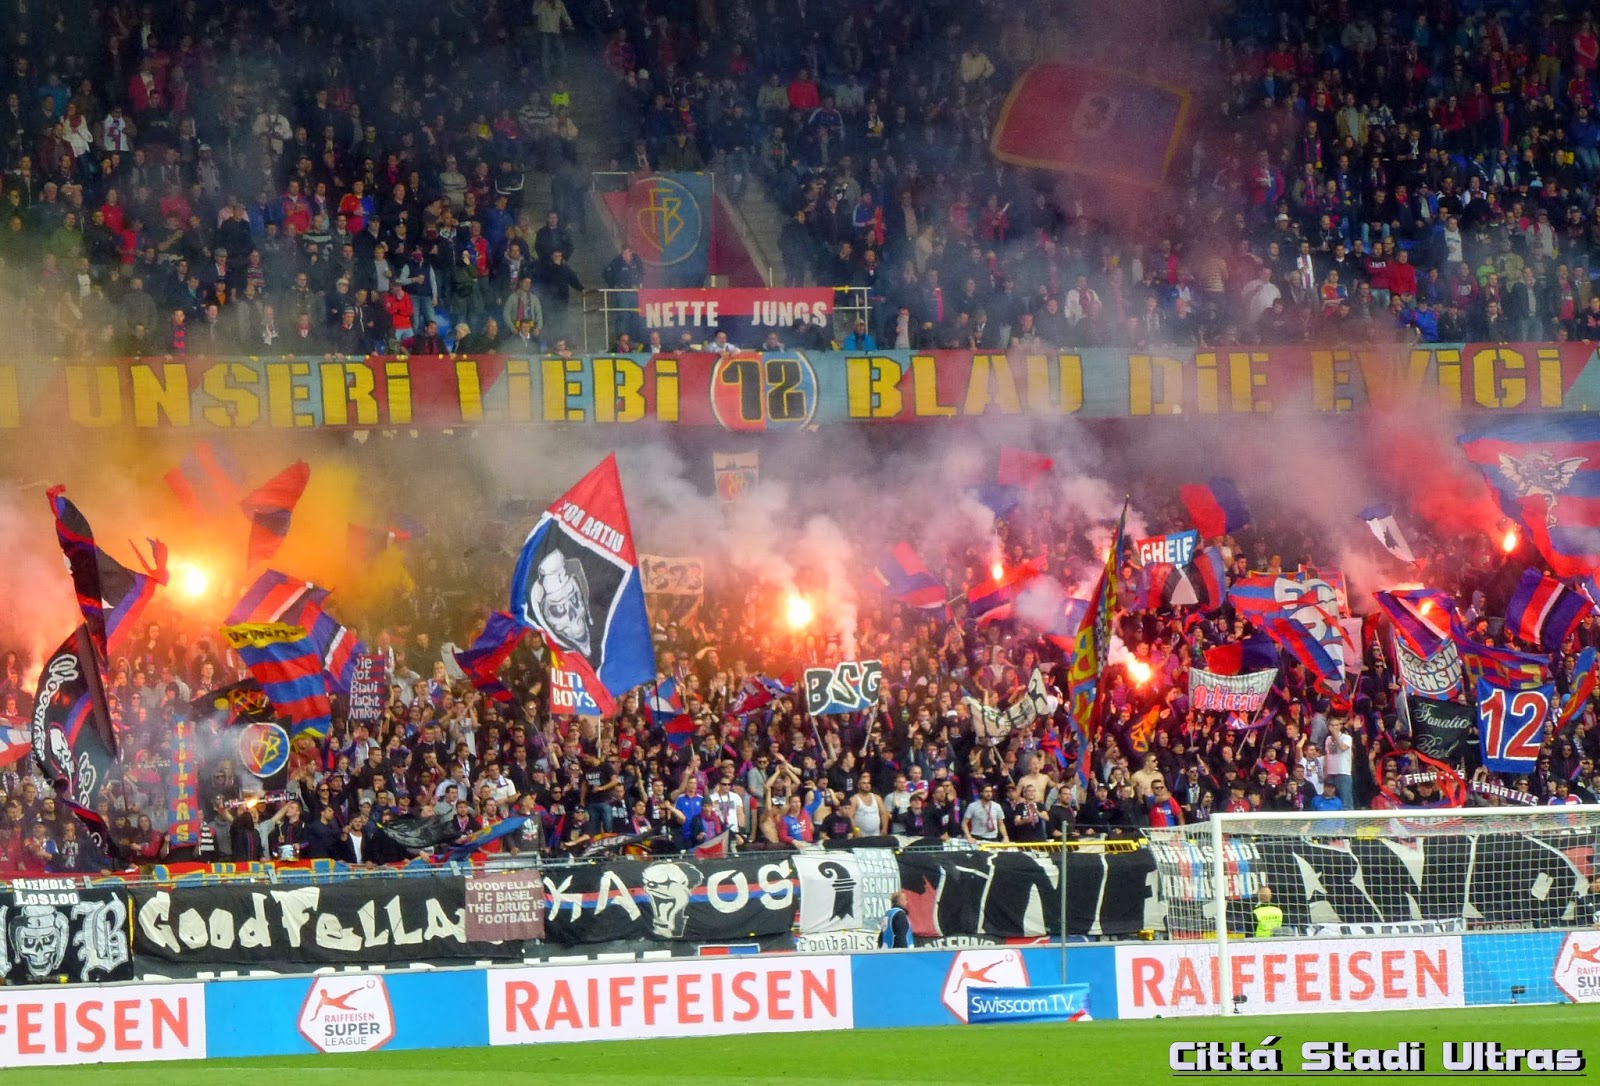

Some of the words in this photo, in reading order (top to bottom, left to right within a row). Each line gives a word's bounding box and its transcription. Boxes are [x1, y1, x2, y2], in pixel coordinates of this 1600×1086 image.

[645, 301, 719, 328] NETTE
[751, 301, 827, 328] JUNGS
[721, 358, 806, 422] 12
[845, 354, 1084, 420] BLAU
[805, 660, 882, 714] BSG
[552, 687, 597, 707] BOYS
[1480, 688, 1549, 762] 12
[1472, 780, 1539, 807] FANATICS
[466, 880, 543, 891] GOODFELLAS
[477, 892, 493, 902] FC
[496, 890, 534, 902] BASEL
[467, 903, 493, 913] THE
[496, 901, 530, 913] DRUG
[532, 900, 545, 910] IS
[478, 911, 539, 924] FOOTBALL
[1131, 949, 1449, 1008] RAIFFEISEN
[1577, 976, 1600, 989] SU
[505, 968, 837, 1033] RAIFFEISEN
[971, 995, 1049, 1014] Swisscom
[0, 997, 189, 1055] EISEN
[326, 1013, 375, 1023] RAIFFEISEN
[325, 1022, 380, 1037] SUPER
[325, 1036, 368, 1047] LEAGUE
